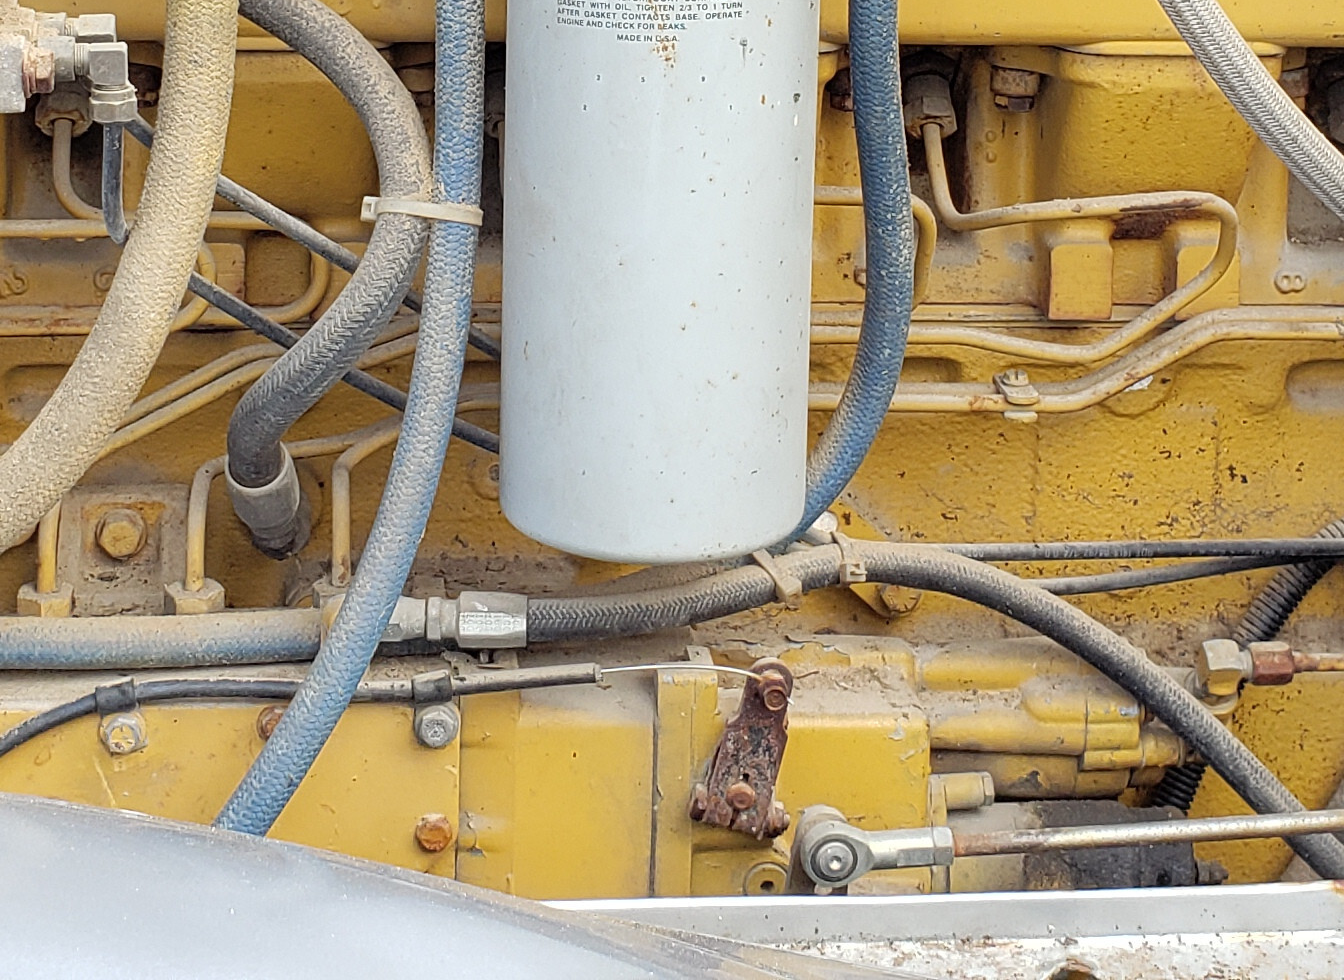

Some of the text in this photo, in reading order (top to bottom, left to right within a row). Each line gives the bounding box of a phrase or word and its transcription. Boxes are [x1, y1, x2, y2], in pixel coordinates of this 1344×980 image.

[557, 0, 586, 8] GASKET
[557, 7, 580, 16] AFTER
[584, 10, 617, 19] GASKET
[621, 12, 671, 21] CONTACTS
[705, 11, 743, 20] OPERATE
[557, 17, 584, 26] ENGINE
[586, 20, 603, 28] AND
[605, 21, 635, 29] CHECK
[637, 22, 655, 30] FOR
[616, 34, 642, 42] MADE
